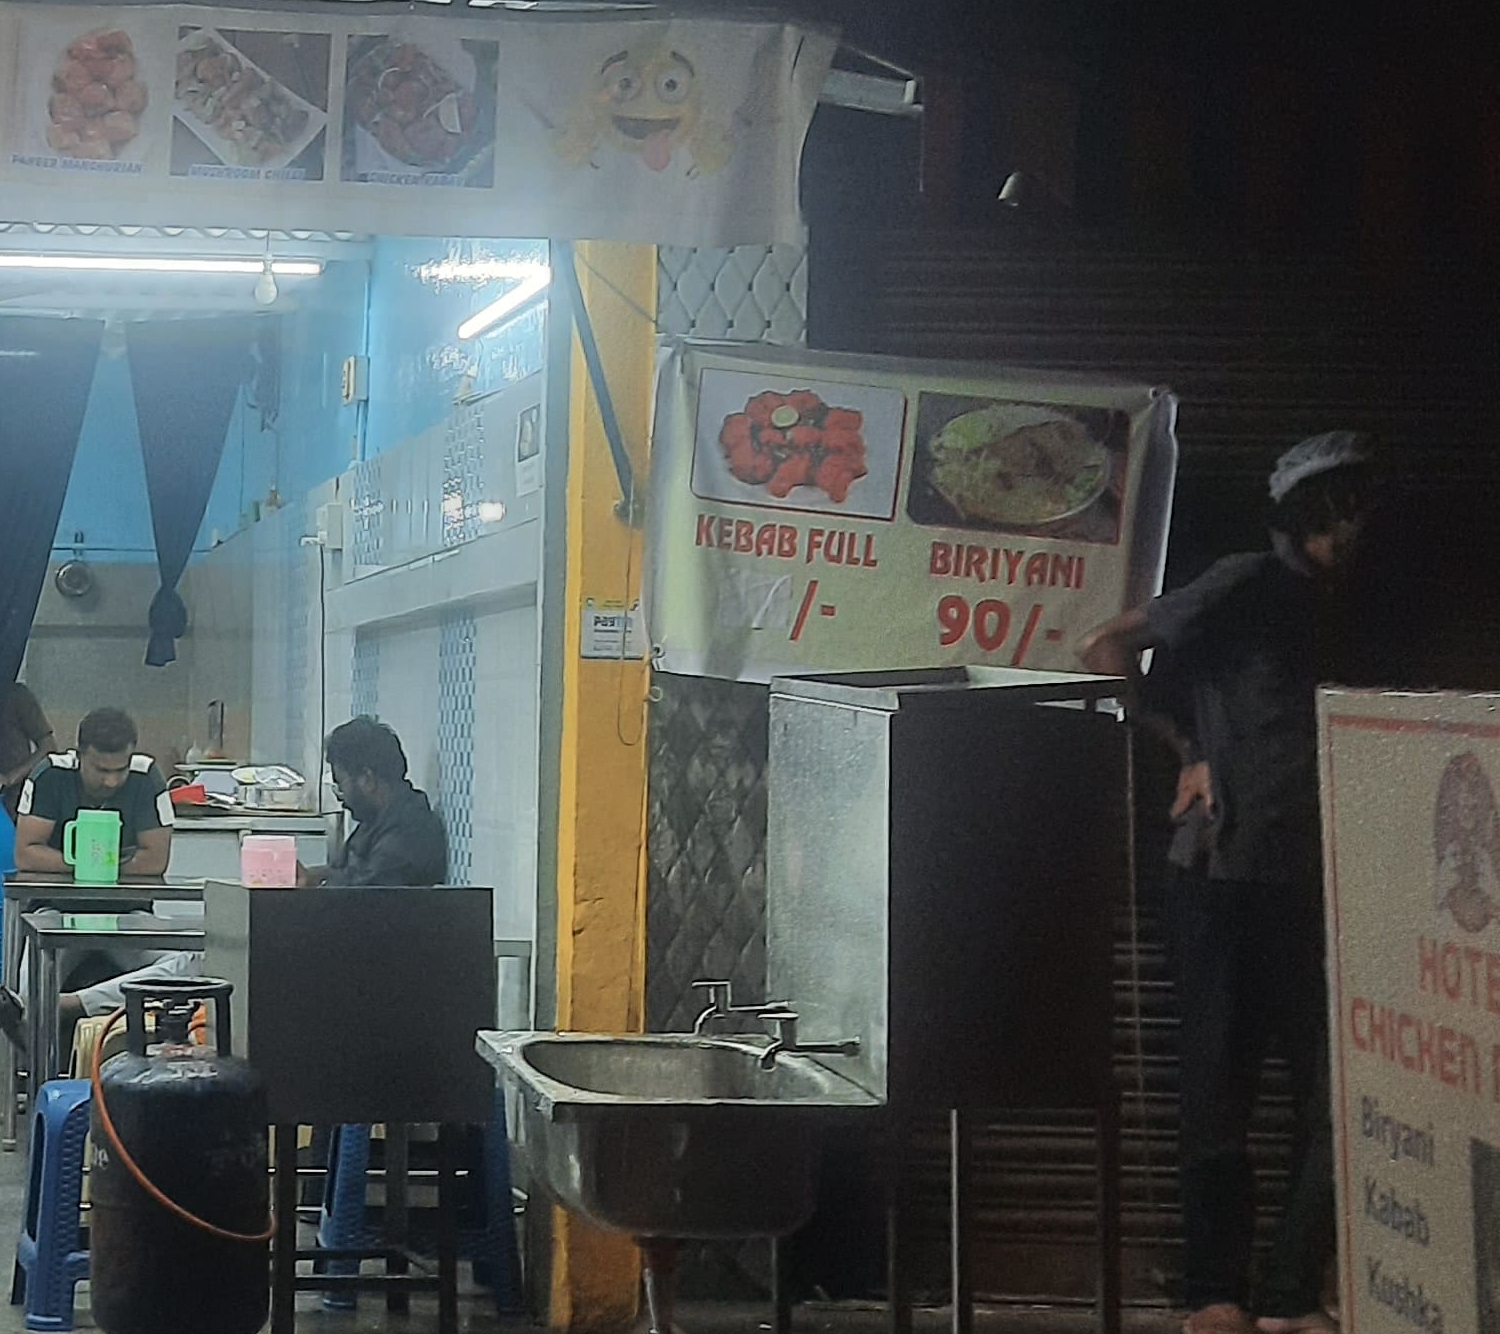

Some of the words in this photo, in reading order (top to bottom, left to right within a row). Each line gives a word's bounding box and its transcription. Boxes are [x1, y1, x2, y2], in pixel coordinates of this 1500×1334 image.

[695, 513, 798, 559] KEBAB
[805, 527, 879, 568] FULL
[928, 540, 1086, 590] BIRIYANI
[936, 594, 1063, 667] 90/-
[1351, 996, 1482, 1095] CHICKEN
[1362, 1094, 1435, 1167] Biryani
[1363, 1175, 1430, 1247] Kabab
